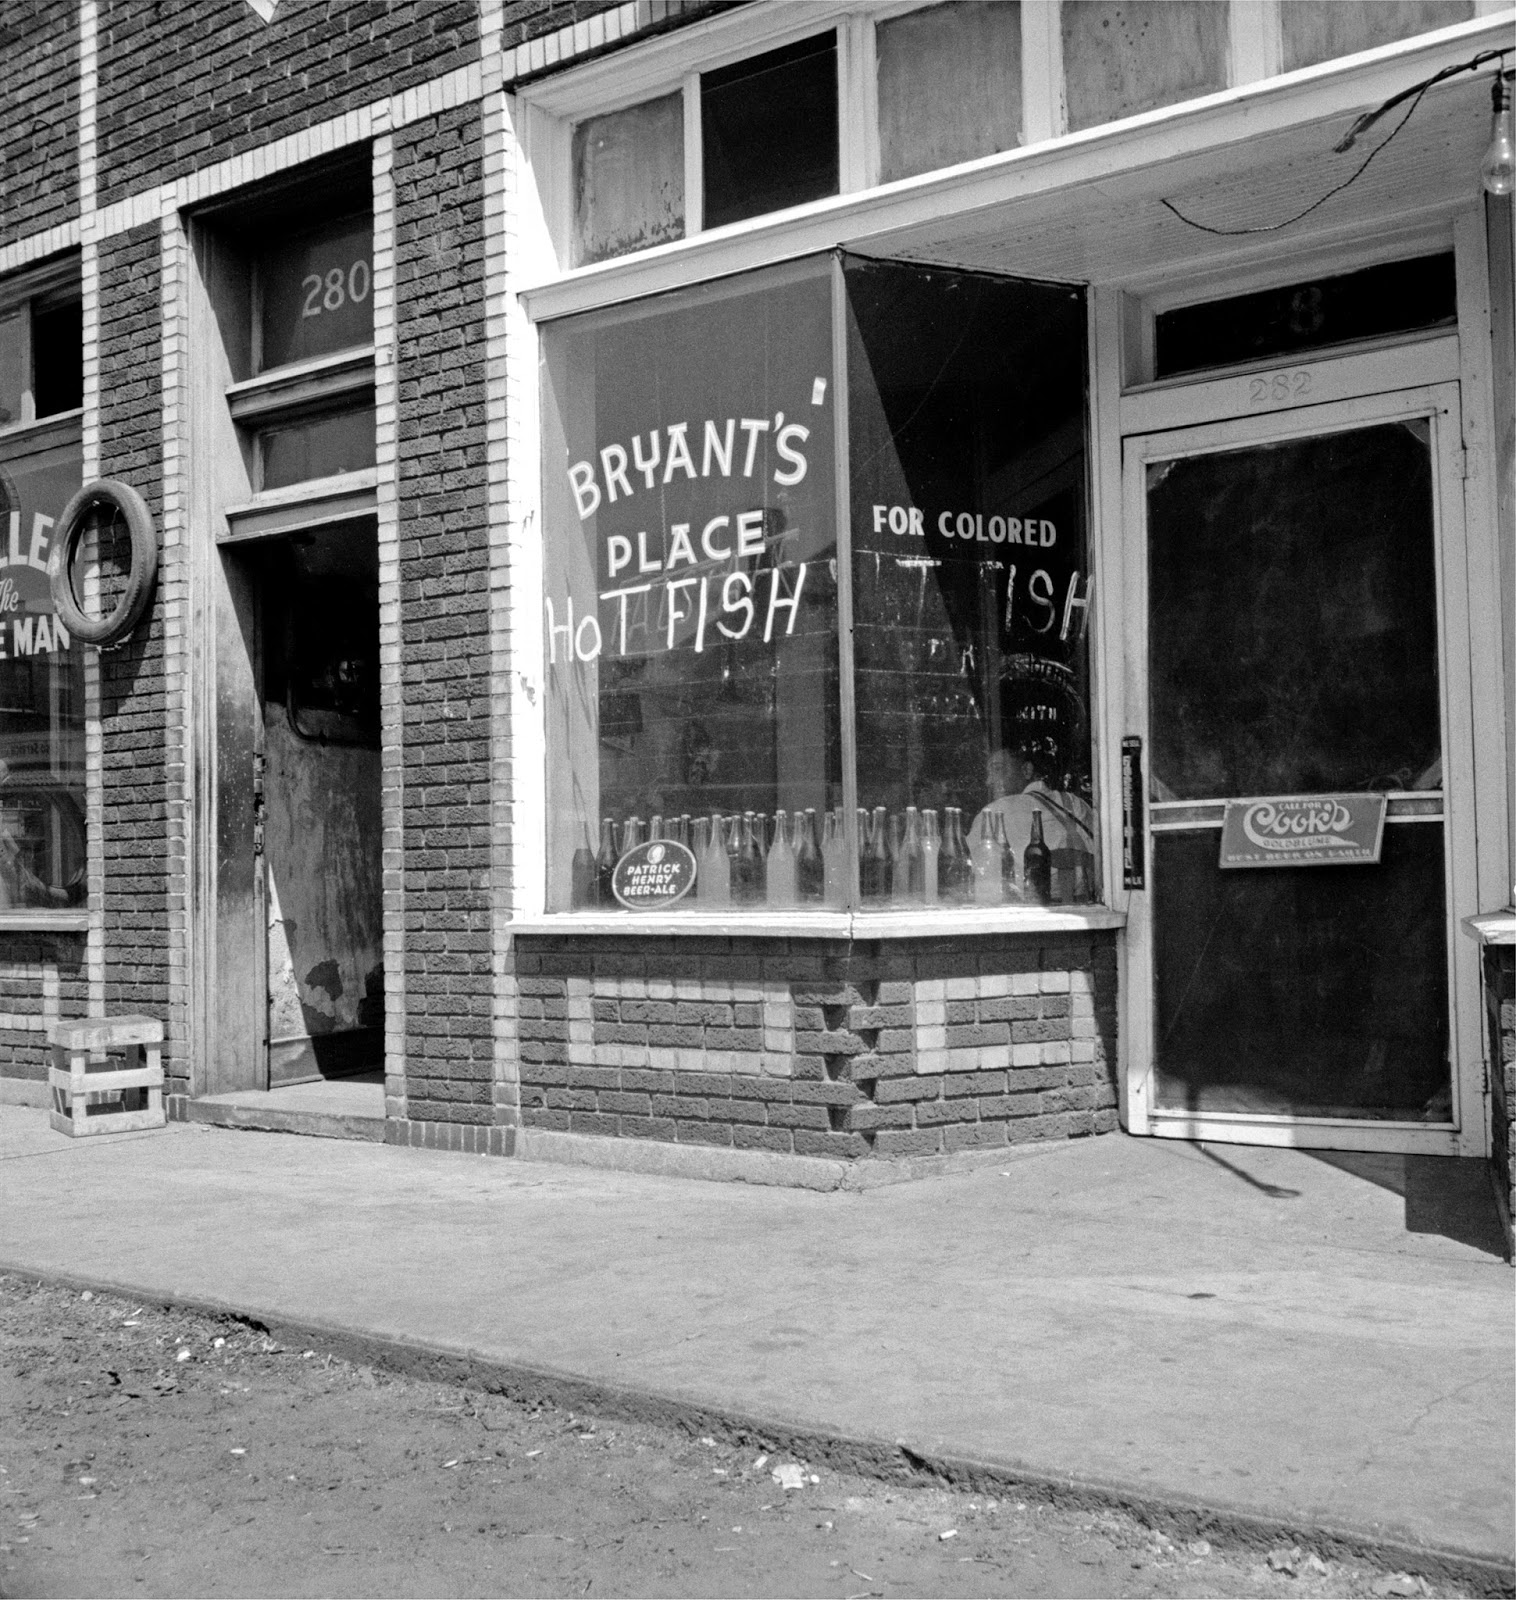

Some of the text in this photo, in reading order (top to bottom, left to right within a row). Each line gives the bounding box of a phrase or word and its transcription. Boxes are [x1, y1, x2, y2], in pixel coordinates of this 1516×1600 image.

[302, 260, 370, 319] 280
[1251, 371, 1312, 401] 282
[567, 411, 811, 521] BRYANT'S
[607, 510, 766, 577] PLACE
[873, 505, 1057, 548] FOR COLORED
[546, 583, 650, 663] HOT
[667, 563, 807, 652] FISH
[13, 613, 70, 658] MAN
[1278, 801, 1322, 811] CALL FOR
[627, 863, 681, 876] PATRICK
[631, 874, 673, 886] HENRY
